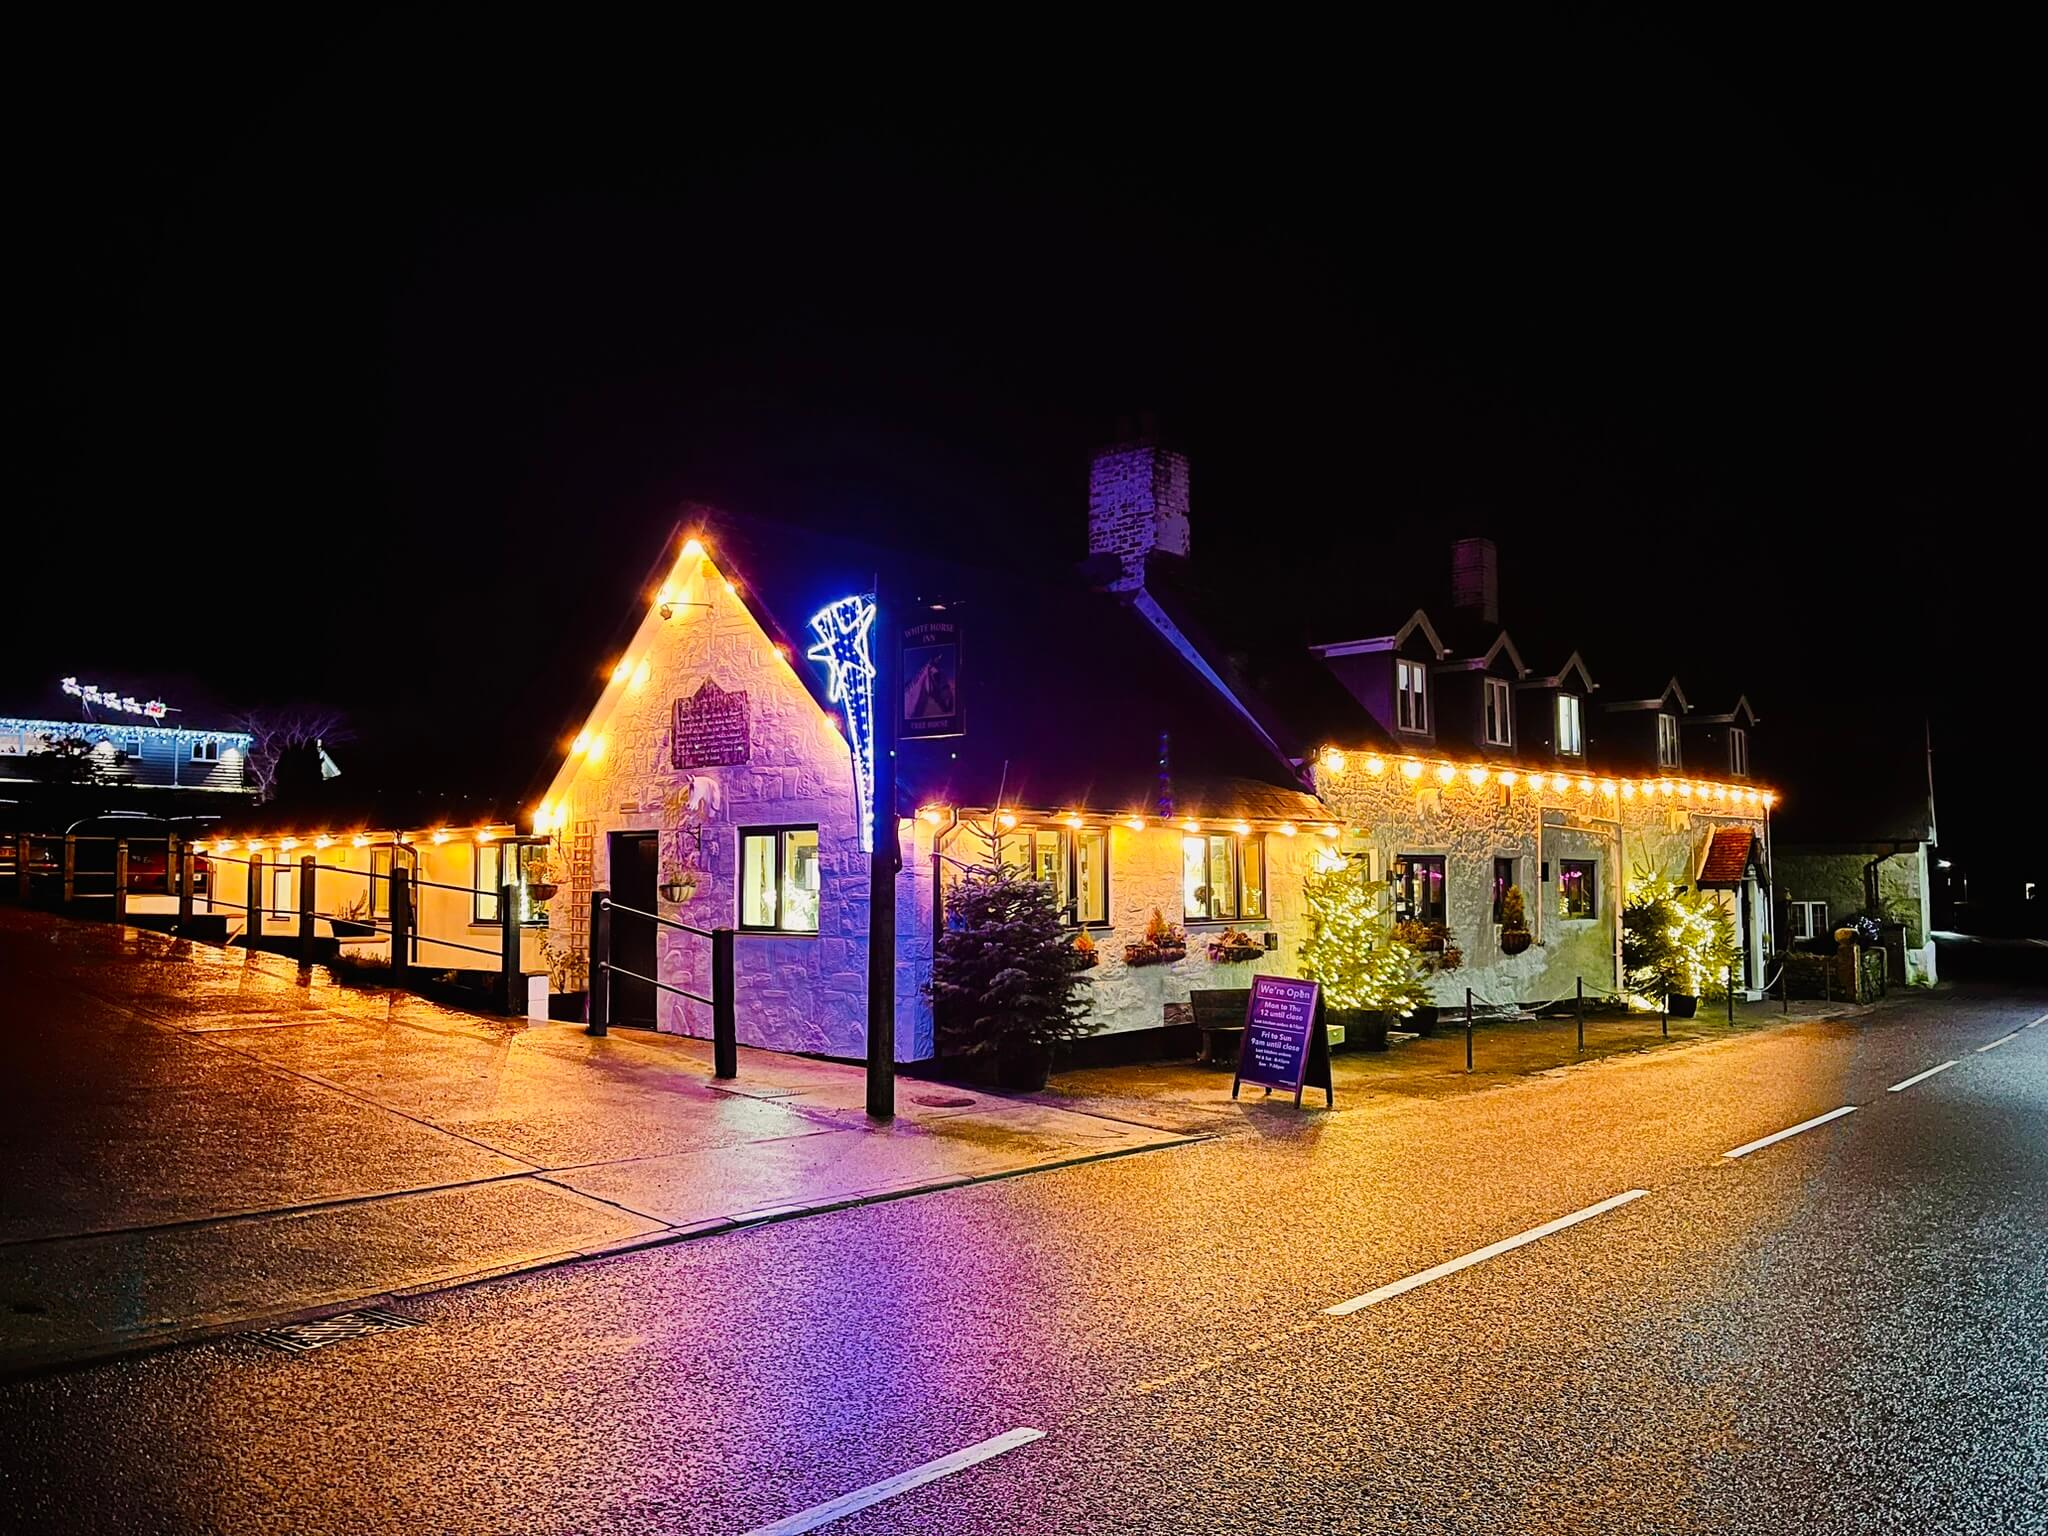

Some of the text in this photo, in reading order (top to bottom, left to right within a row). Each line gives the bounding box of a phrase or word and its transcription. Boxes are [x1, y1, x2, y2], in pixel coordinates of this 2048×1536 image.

[1260, 984, 1310, 999] We're Open
[1264, 1001, 1279, 1009] Mon
[1289, 1004, 1301, 1012] Thu
[1286, 1013, 1303, 1021] close
[1279, 1033, 1292, 1041] Sun
[1251, 1037, 1300, 1052] 9am until close
